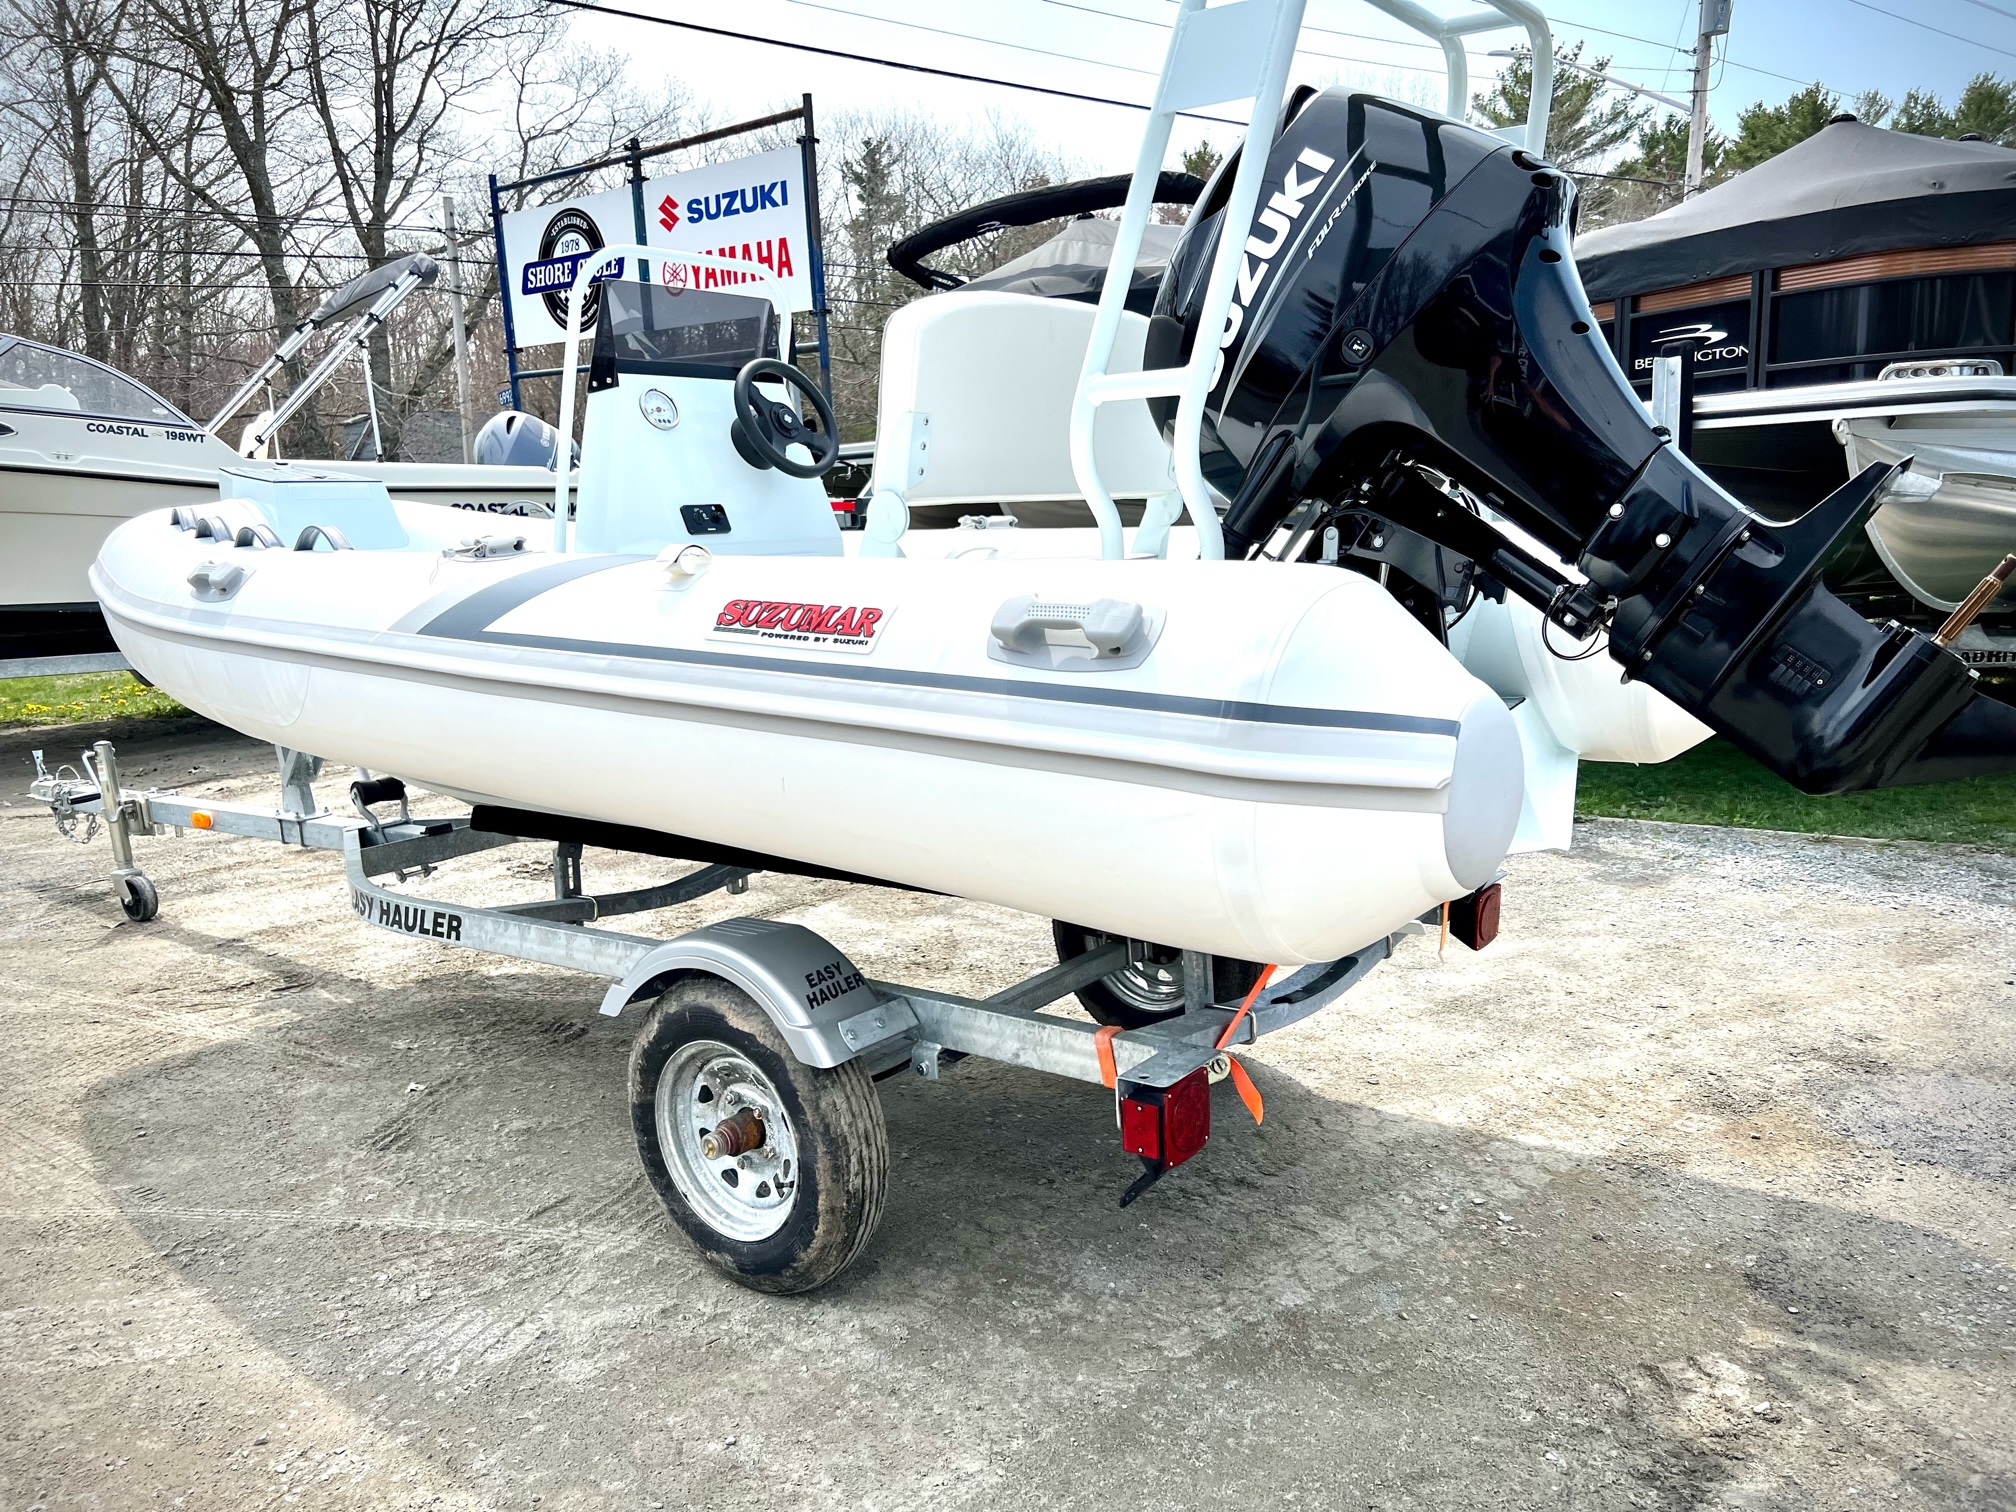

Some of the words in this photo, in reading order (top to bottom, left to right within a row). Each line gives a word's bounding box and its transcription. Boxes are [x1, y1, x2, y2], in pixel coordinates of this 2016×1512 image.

[686, 180, 788, 224] SUZUKI
[551, 216, 588, 236] ESTABLISHED
[561, 238, 580, 254] 1978
[527, 262, 572, 288] SHORE
[86, 423, 149, 438] COASTAL
[165, 430, 206, 443] 198WT
[716, 599, 883, 638] SUZUMAR
[760, 632, 809, 642] POWERED
[379, 900, 462, 942] HAULER
[804, 961, 843, 989] EASY
[806, 972, 866, 1010] HAULER
